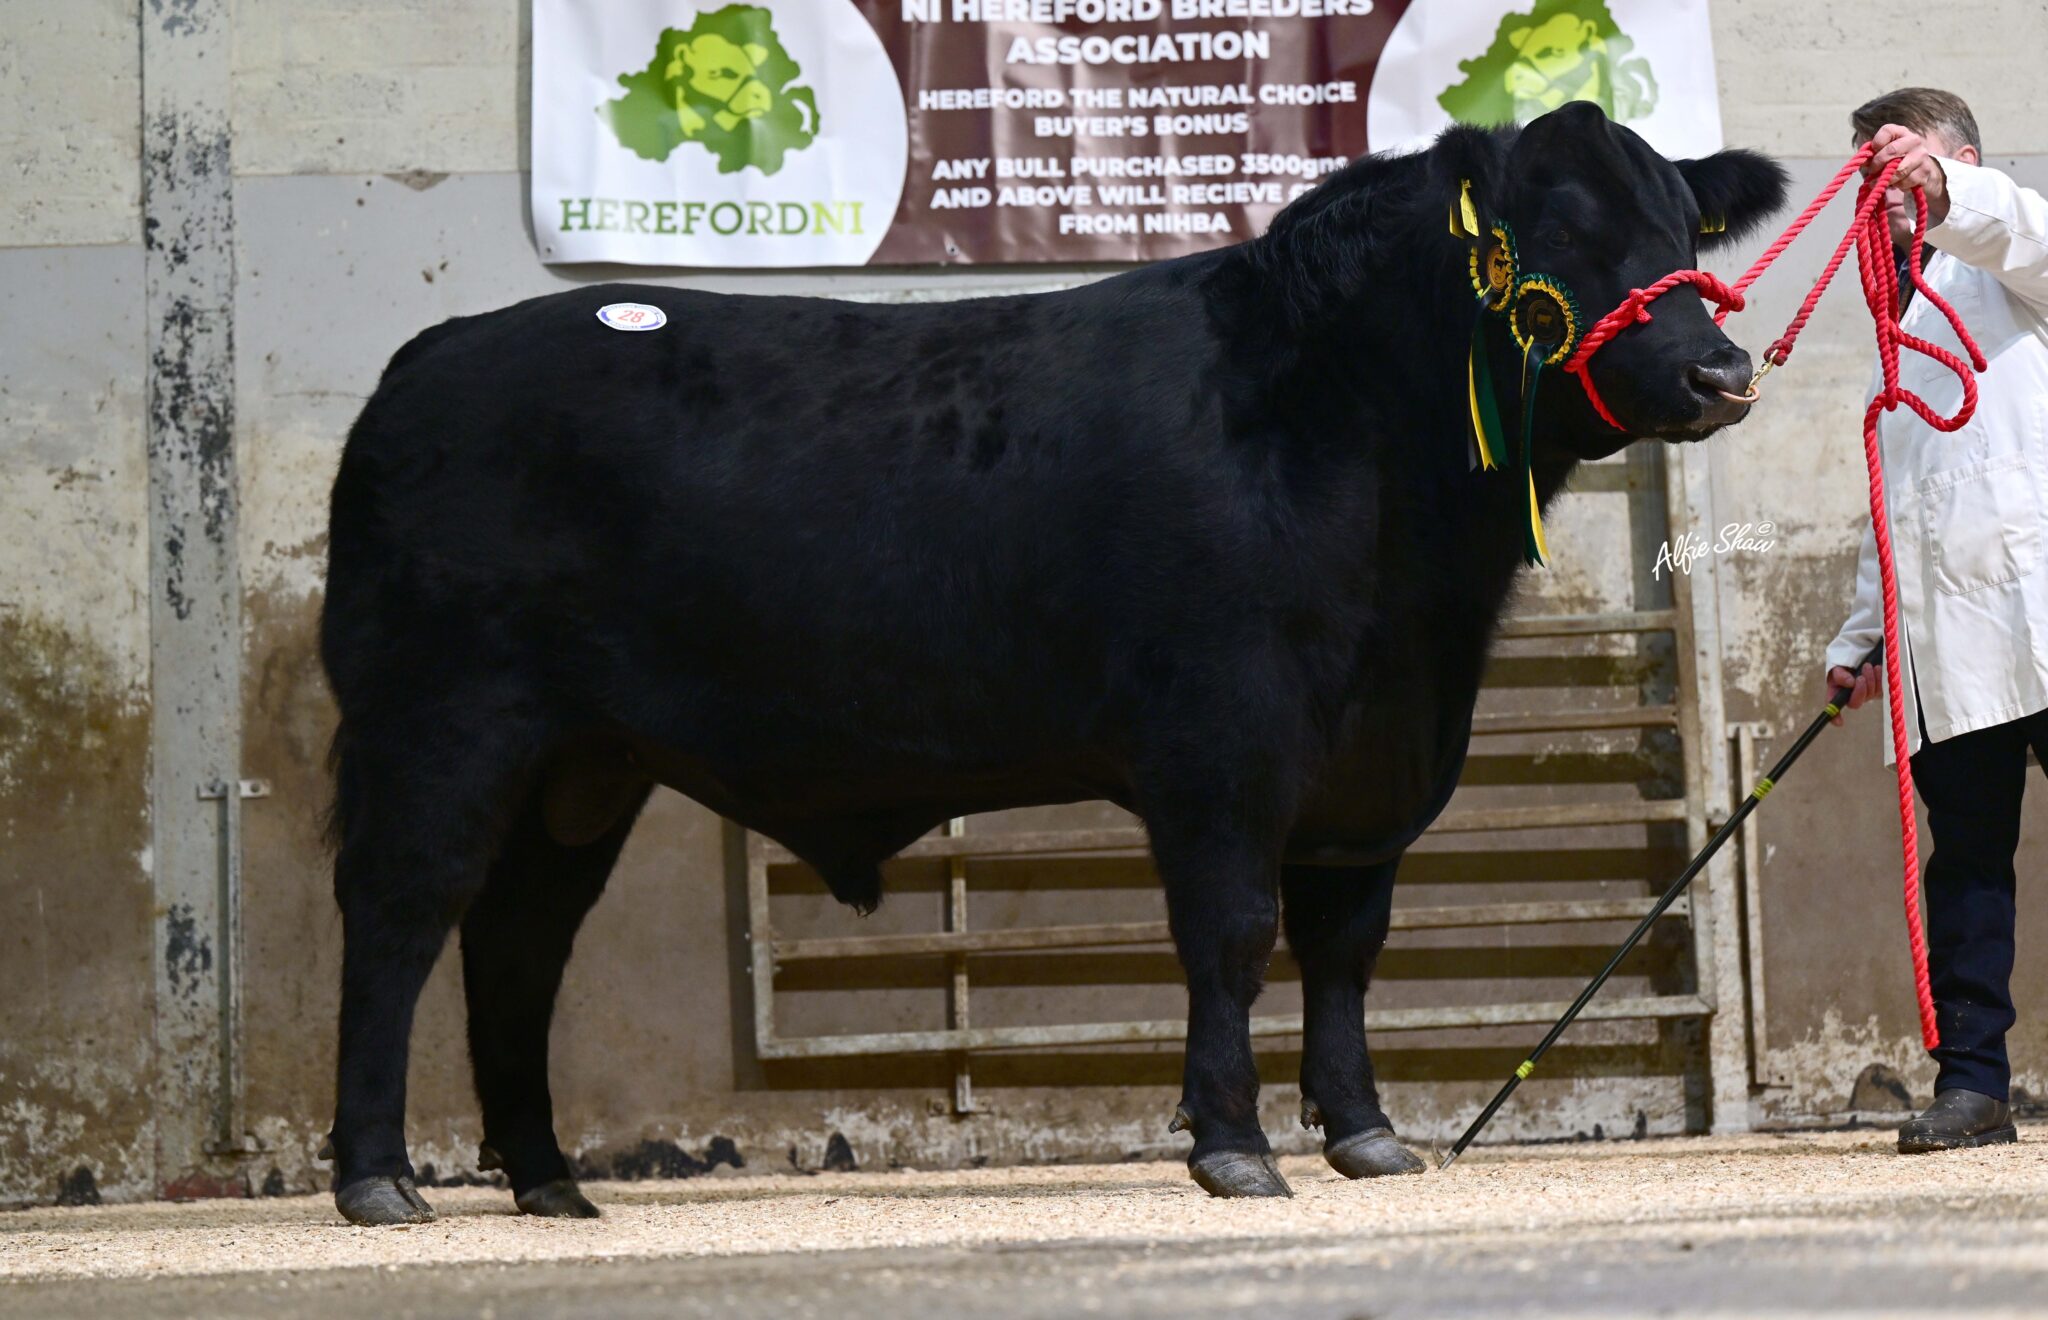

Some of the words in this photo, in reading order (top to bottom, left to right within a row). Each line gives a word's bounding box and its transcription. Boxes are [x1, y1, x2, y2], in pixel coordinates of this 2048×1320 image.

[901, 0, 942, 22] NI
[952, 0, 1162, 22] HEREFORD
[1172, 0, 1373, 19] BREEDERS
[1006, 31, 1270, 64] ASSOCIATION
[919, 88, 1065, 110] HEREFORD
[1069, 88, 1123, 108] THE
[1128, 84, 1255, 108] NATURAL
[1259, 81, 1357, 105] CHOICE
[1034, 116, 1149, 137] BUYER'S
[1153, 112, 1249, 135] BONUS
[931, 158, 990, 180] ANY
[996, 157, 1066, 178] BULL
[1070, 154, 1236, 177] PURCHASED
[930, 187, 992, 209] AND
[996, 186, 1092, 206] ABOVE
[1097, 184, 1166, 206] WILL
[1171, 182, 1283, 205] RECIEVE
[559, 198, 865, 235] HEREFORDNI
[1059, 213, 1139, 234] FROM
[1143, 211, 1232, 234] NIHBA
[617, 310, 645, 324] 28
